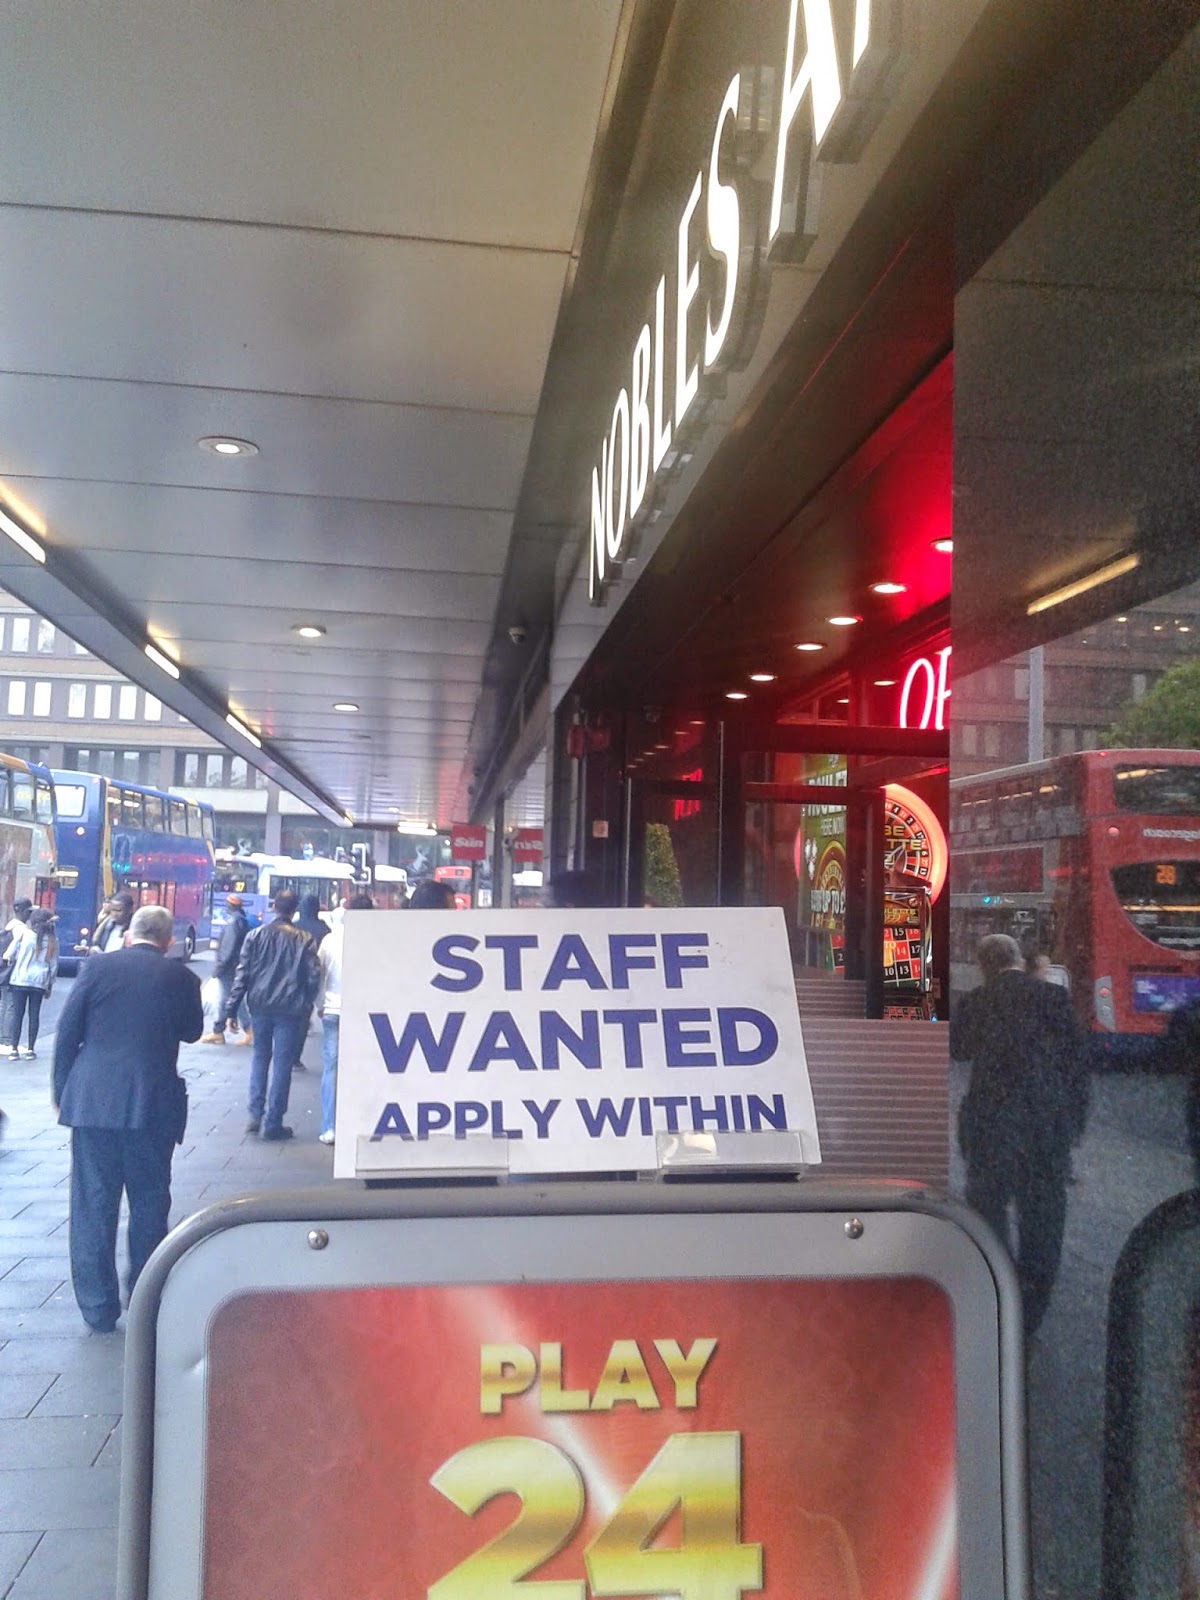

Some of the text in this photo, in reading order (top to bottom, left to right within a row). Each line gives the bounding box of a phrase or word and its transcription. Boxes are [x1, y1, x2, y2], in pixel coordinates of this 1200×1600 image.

[588, 0, 871, 600] NOBLES A
[430, 933, 709, 992] STAFF
[894, 928, 904, 936] 15
[884, 967, 894, 976] 10
[900, 966, 909, 974] 13
[369, 1007, 779, 1073] WANTED
[369, 1093, 788, 1142] APPLY WITHIN
[479, 1338, 719, 1415] PLAY
[427, 1430, 764, 1600] 24
